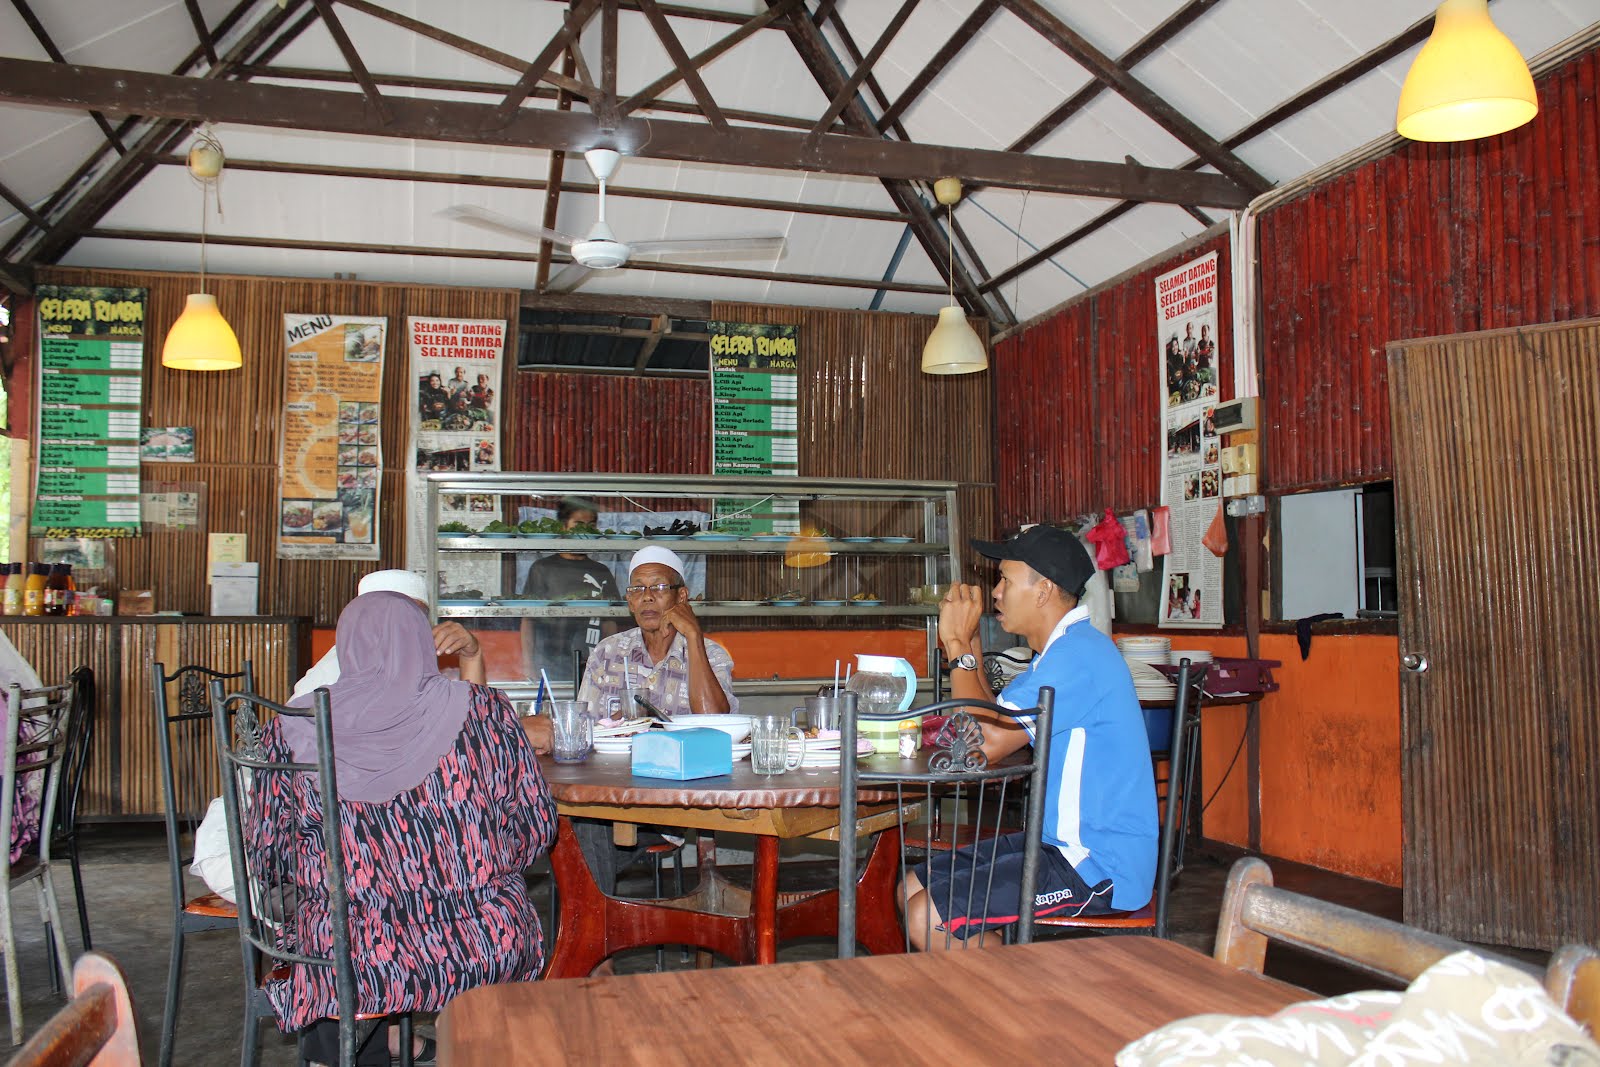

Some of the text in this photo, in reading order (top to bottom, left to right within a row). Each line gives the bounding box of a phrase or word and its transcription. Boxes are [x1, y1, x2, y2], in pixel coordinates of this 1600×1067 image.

[1159, 259, 1215, 294] SELAMAT DATANG
[1160, 274, 1216, 308] SELERA RIMBA
[40, 298, 143, 322] SELERA RIMBA
[1165, 291, 1213, 320] SG.LEMBING
[48, 325, 72, 333] MENU
[287, 314, 333, 342] MENU
[414, 322, 502, 336] SELAMAT DATANG
[414, 334, 502, 347] SELERA RIMBA
[711, 334, 797, 357] SELERA RIMBA
[421, 347, 496, 359] SG.LEMBING
[718, 358, 796, 368] MENU HARGA
